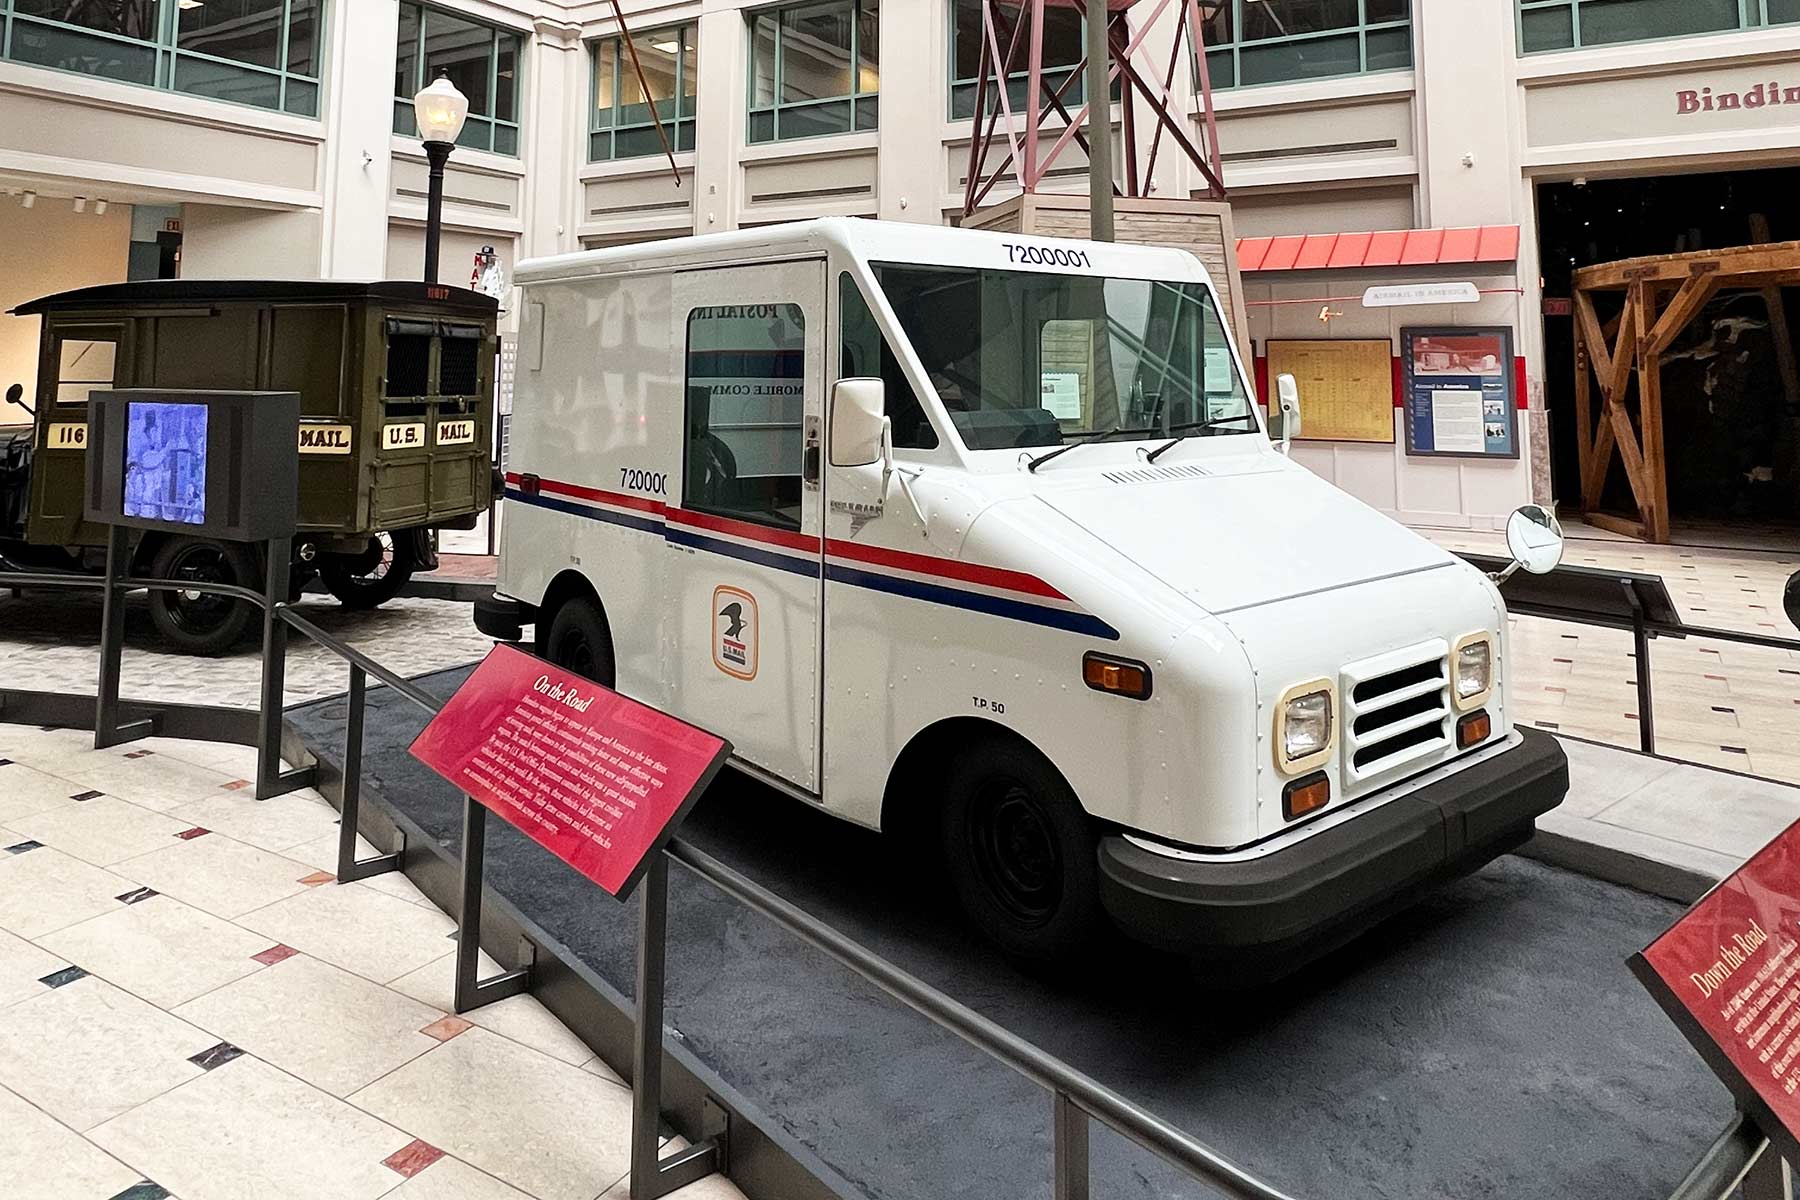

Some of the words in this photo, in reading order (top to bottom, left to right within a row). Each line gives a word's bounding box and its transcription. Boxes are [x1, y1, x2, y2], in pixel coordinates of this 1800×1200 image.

[1002, 244, 1091, 268] 7200001
[60, 427, 84, 443] 116
[300, 430, 349, 447] MAIL
[389, 427, 418, 444] U.S.
[440, 424, 470, 440] MAIL
[534, 675, 550, 694] On
[547, 682, 565, 701] the
[562, 688, 594, 712] Road
[991, 702, 1005, 714] 50
[1732, 918, 1768, 957] Road
[1721, 945, 1746, 971] the
[1690, 961, 1732, 999] Down
